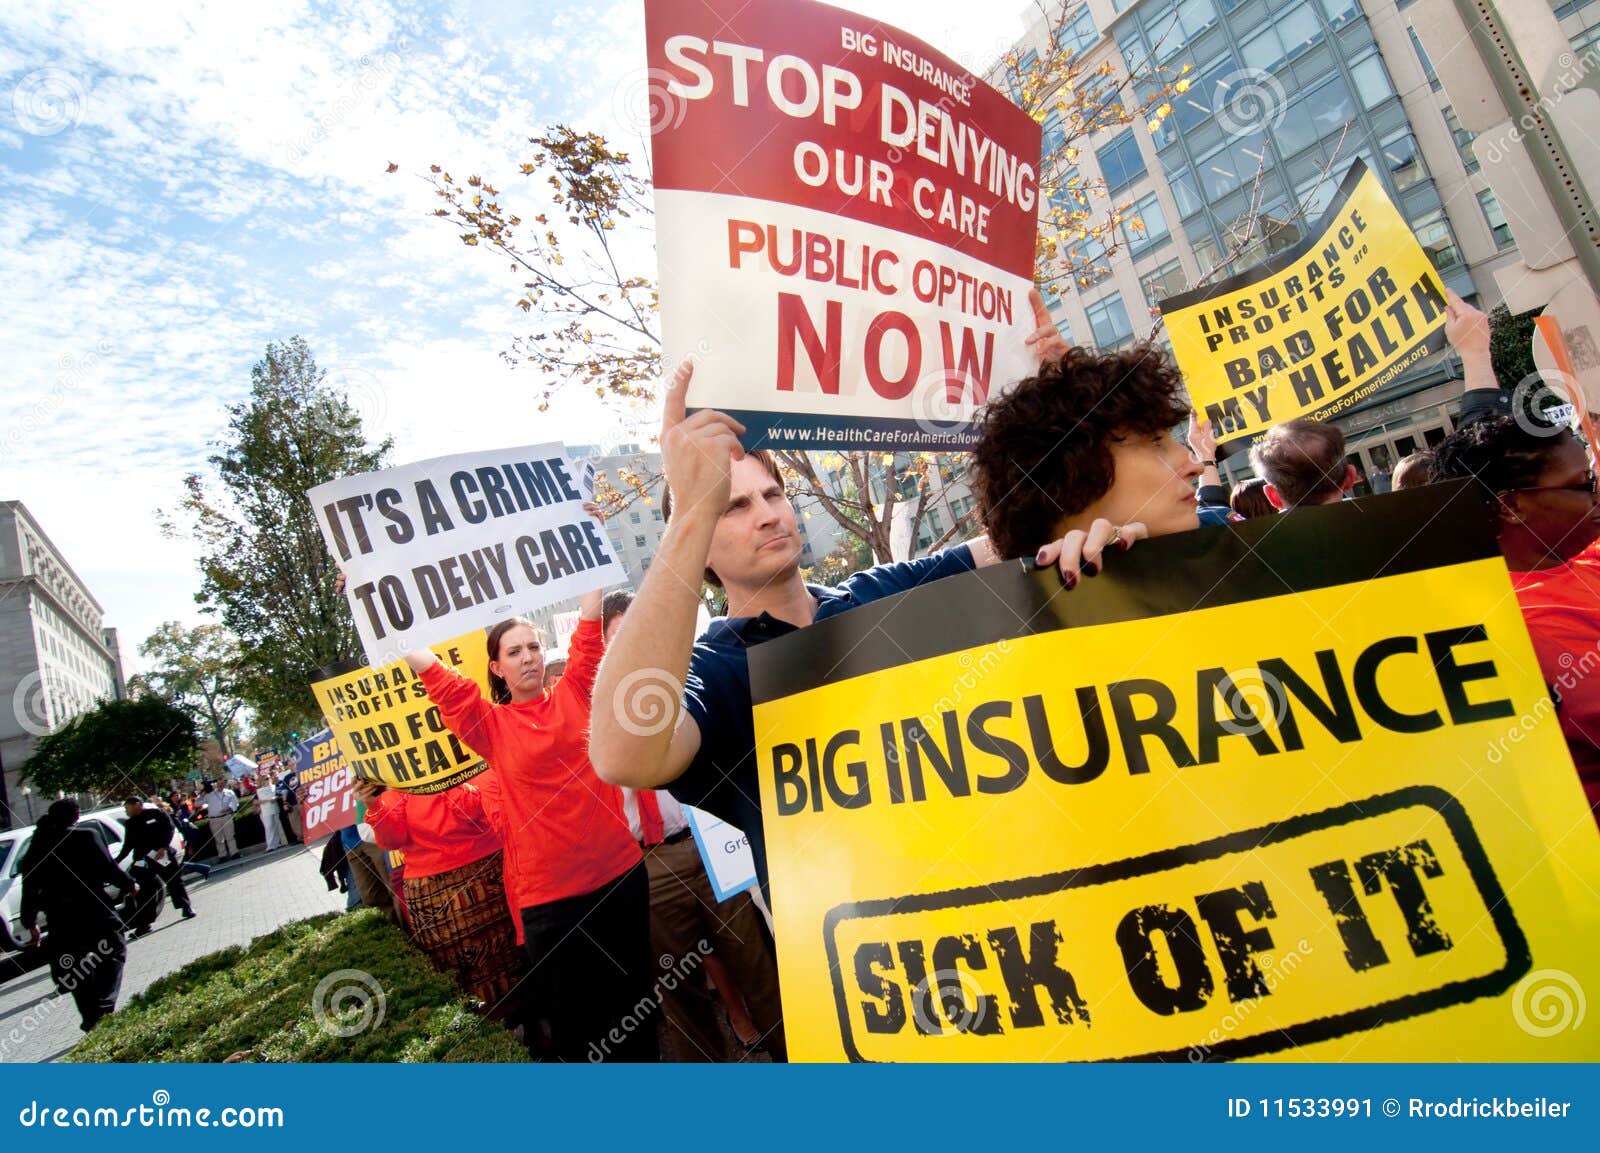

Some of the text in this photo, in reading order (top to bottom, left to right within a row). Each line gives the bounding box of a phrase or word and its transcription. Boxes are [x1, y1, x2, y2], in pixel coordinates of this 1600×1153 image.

[841, 27, 971, 107] BIG INSURANCE:
[664, 35, 1036, 213] STOP DENYING
[793, 141, 990, 244] OUR CARE
[727, 218, 1012, 326] PUBLIC OPTION
[1198, 209, 1368, 333] INSURANCE
[1206, 244, 1369, 352] PROFITS are
[776, 292, 995, 406] NOW
[1205, 271, 1447, 439] MY HEALTH
[1223, 265, 1398, 389] BAD FOR
[768, 426, 980, 446] www.HealthCareForAmericaNow
[323, 457, 582, 562] IT'S A CRIME
[354, 520, 612, 641] TO DENY CARE
[313, 738, 338, 763] BI
[335, 681, 427, 721] PROFITS
[349, 705, 447, 755] BAD FO
[772, 624, 1516, 818] BIG INSURANCE
[300, 755, 347, 784] INSURA
[306, 788, 356, 829] OF I
[387, 734, 471, 783] HEAL
[853, 839, 1452, 1039] SICK OF IT
